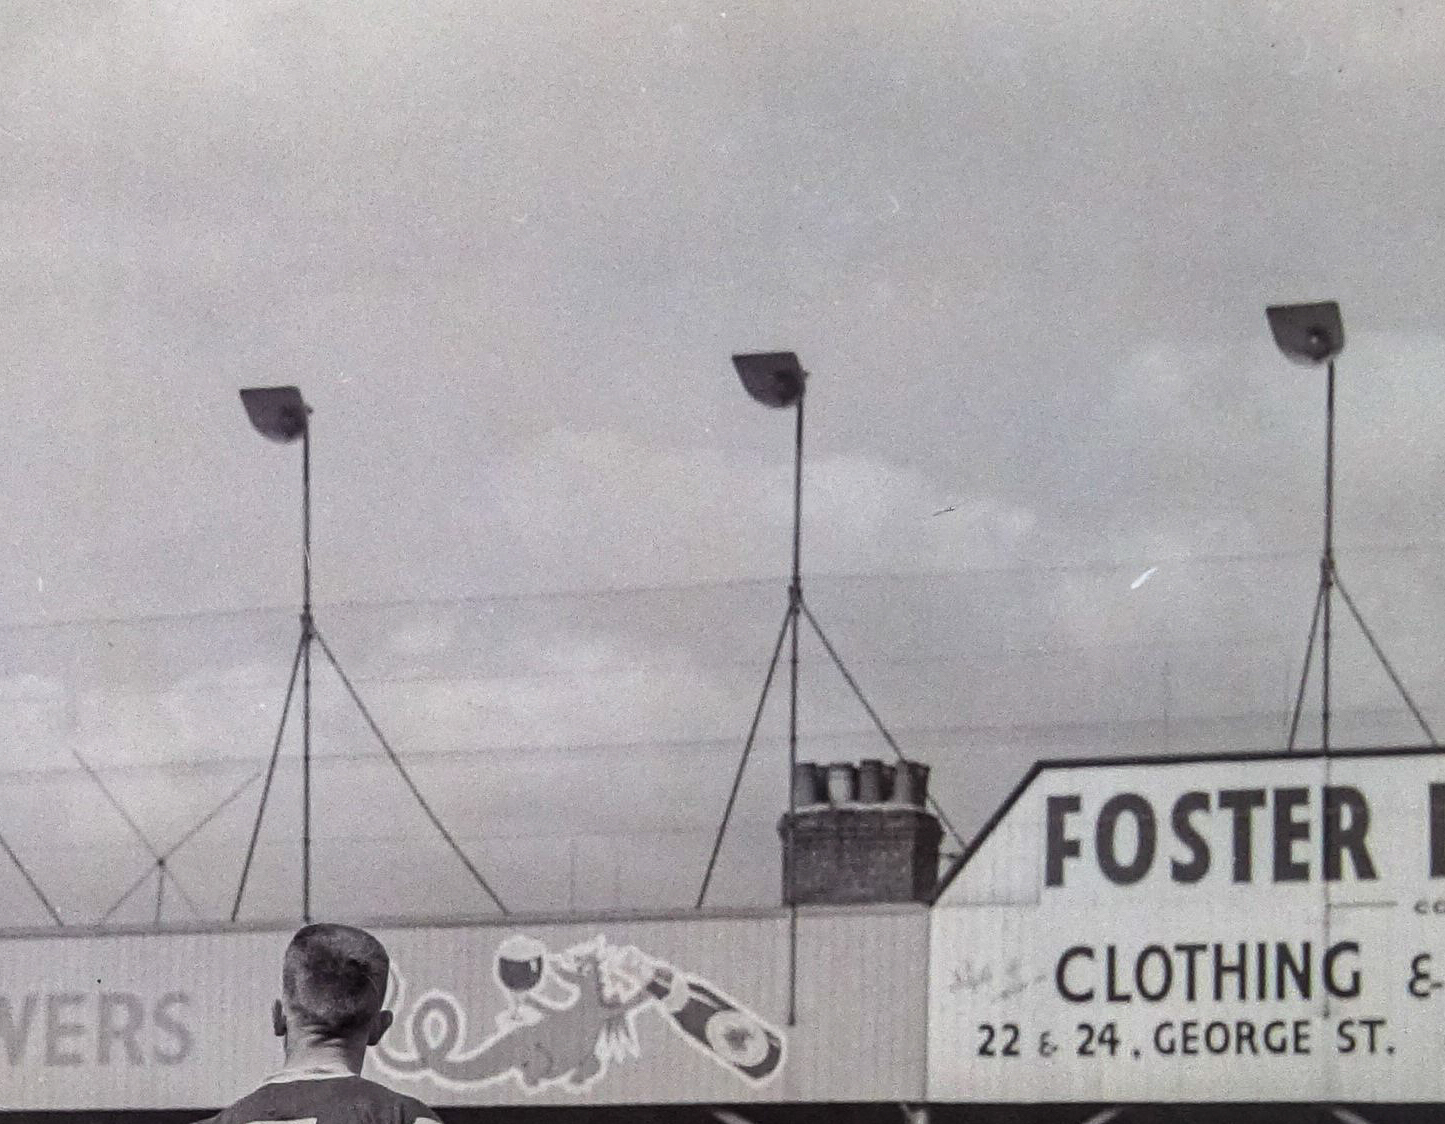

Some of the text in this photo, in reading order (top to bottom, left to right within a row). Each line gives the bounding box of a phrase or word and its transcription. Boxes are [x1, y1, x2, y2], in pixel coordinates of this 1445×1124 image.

[1044, 785, 1378, 887] FOSTER
[1056, 940, 1362, 1003] CLOTHING
[1407, 952, 1443, 999] &
[977, 1022, 1021, 1057] 22
[1038, 1030, 1058, 1057] &
[1154, 1019, 1312, 1055] GEORGE
[1337, 1017, 1396, 1054] ST.
